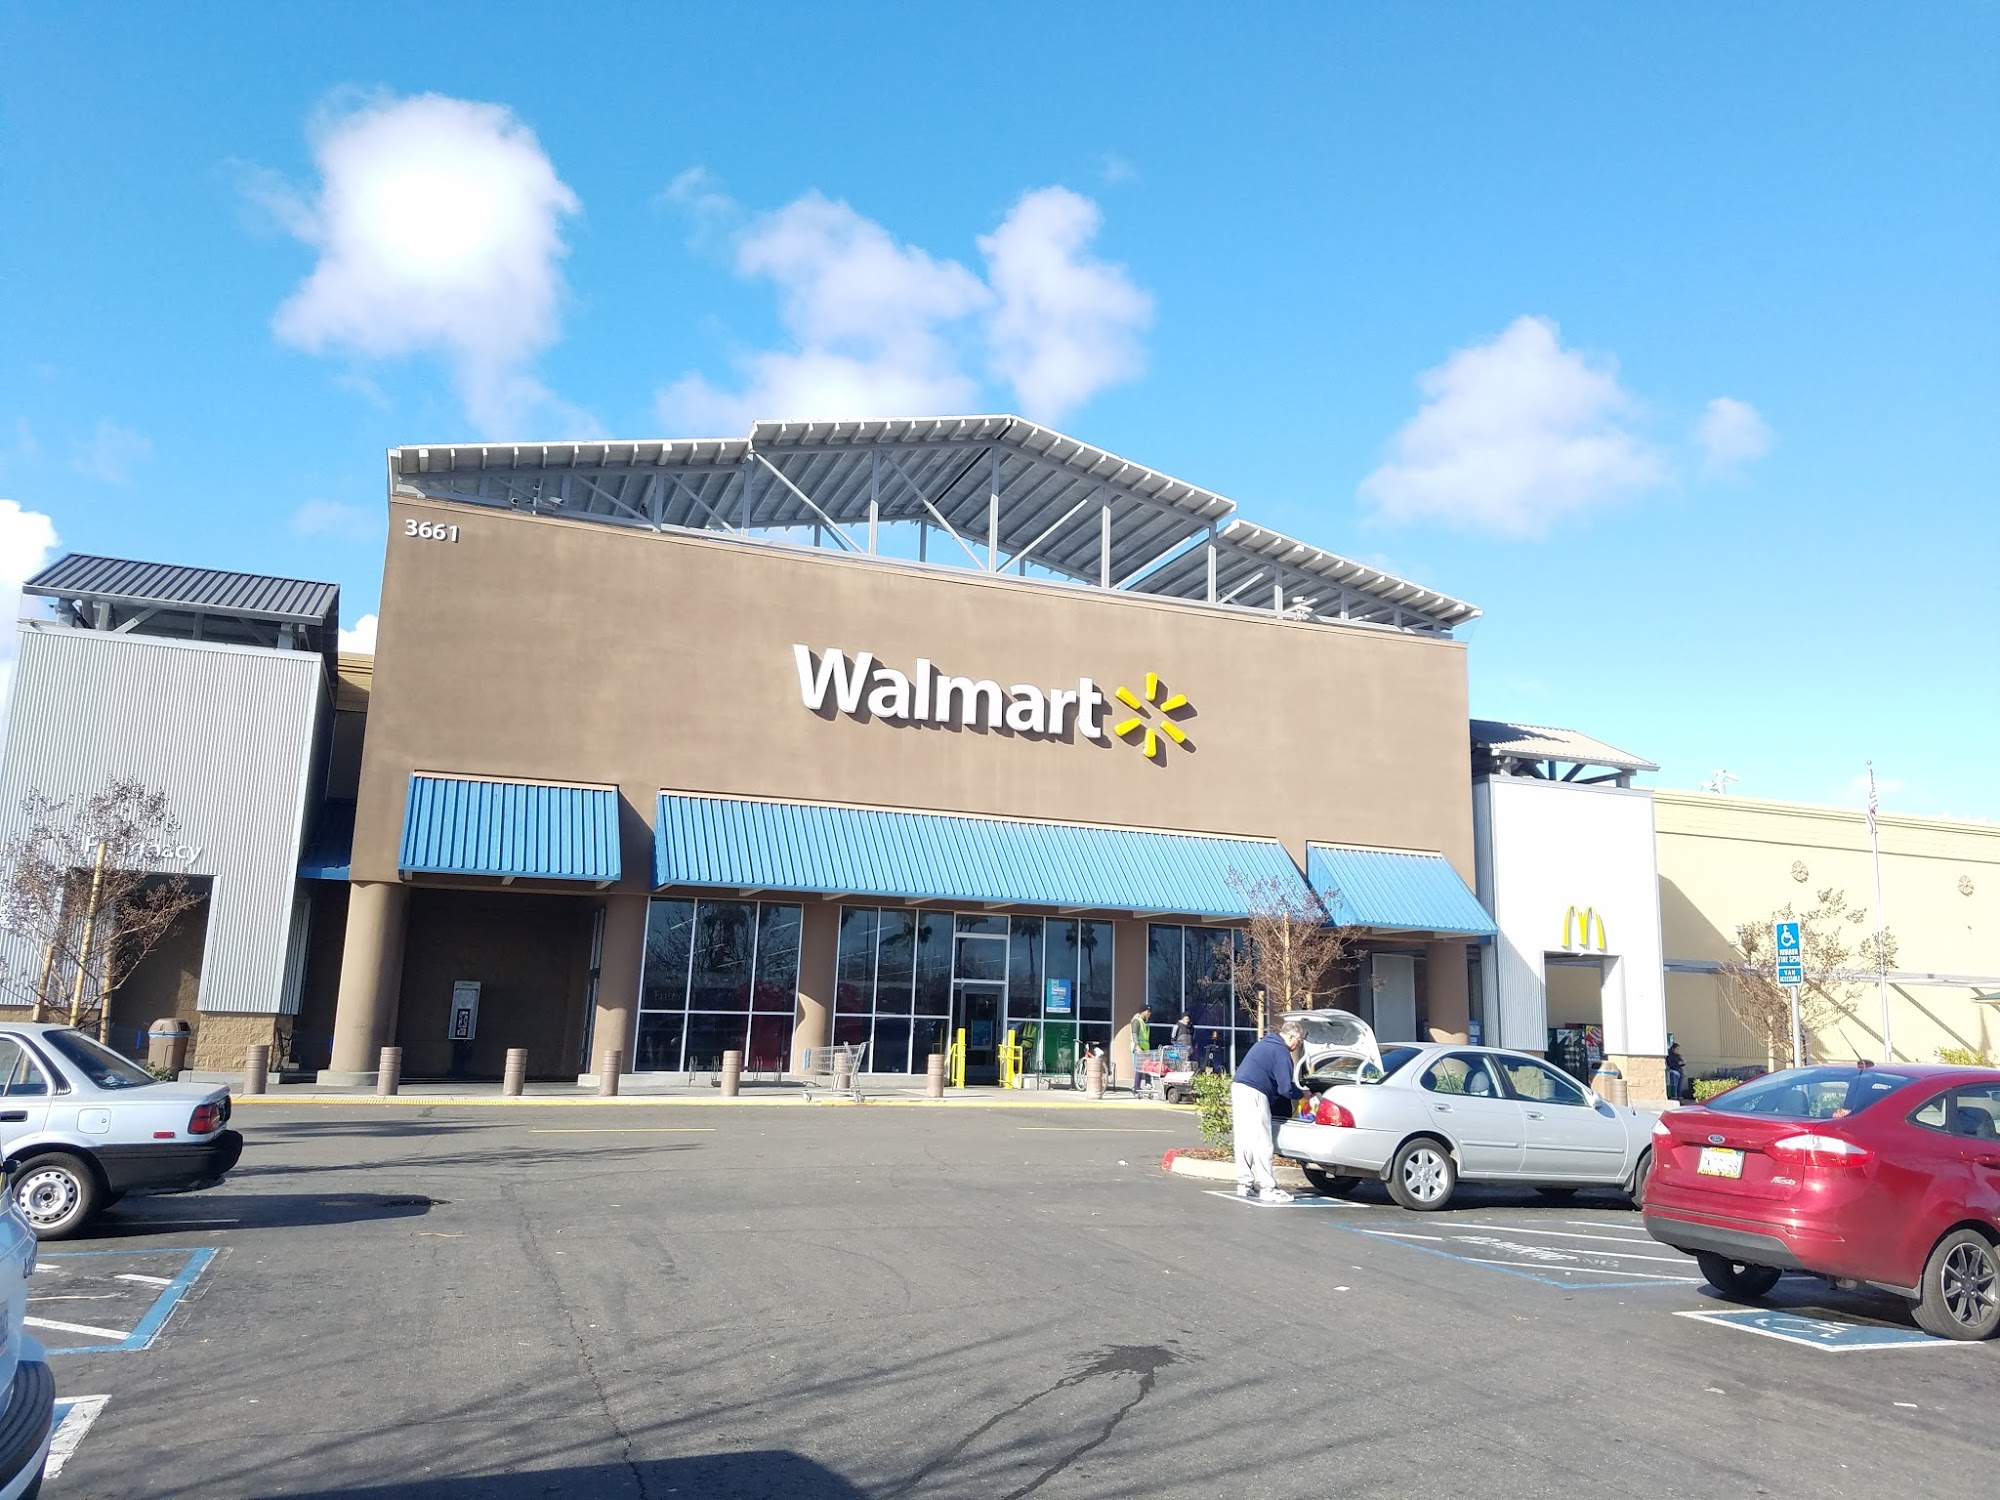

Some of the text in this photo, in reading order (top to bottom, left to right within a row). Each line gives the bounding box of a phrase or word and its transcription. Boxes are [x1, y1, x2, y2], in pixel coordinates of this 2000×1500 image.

[404, 518, 458, 543] 3661
[792, 643, 1103, 740] Walmart
[1783, 969, 1796, 977] VAN
